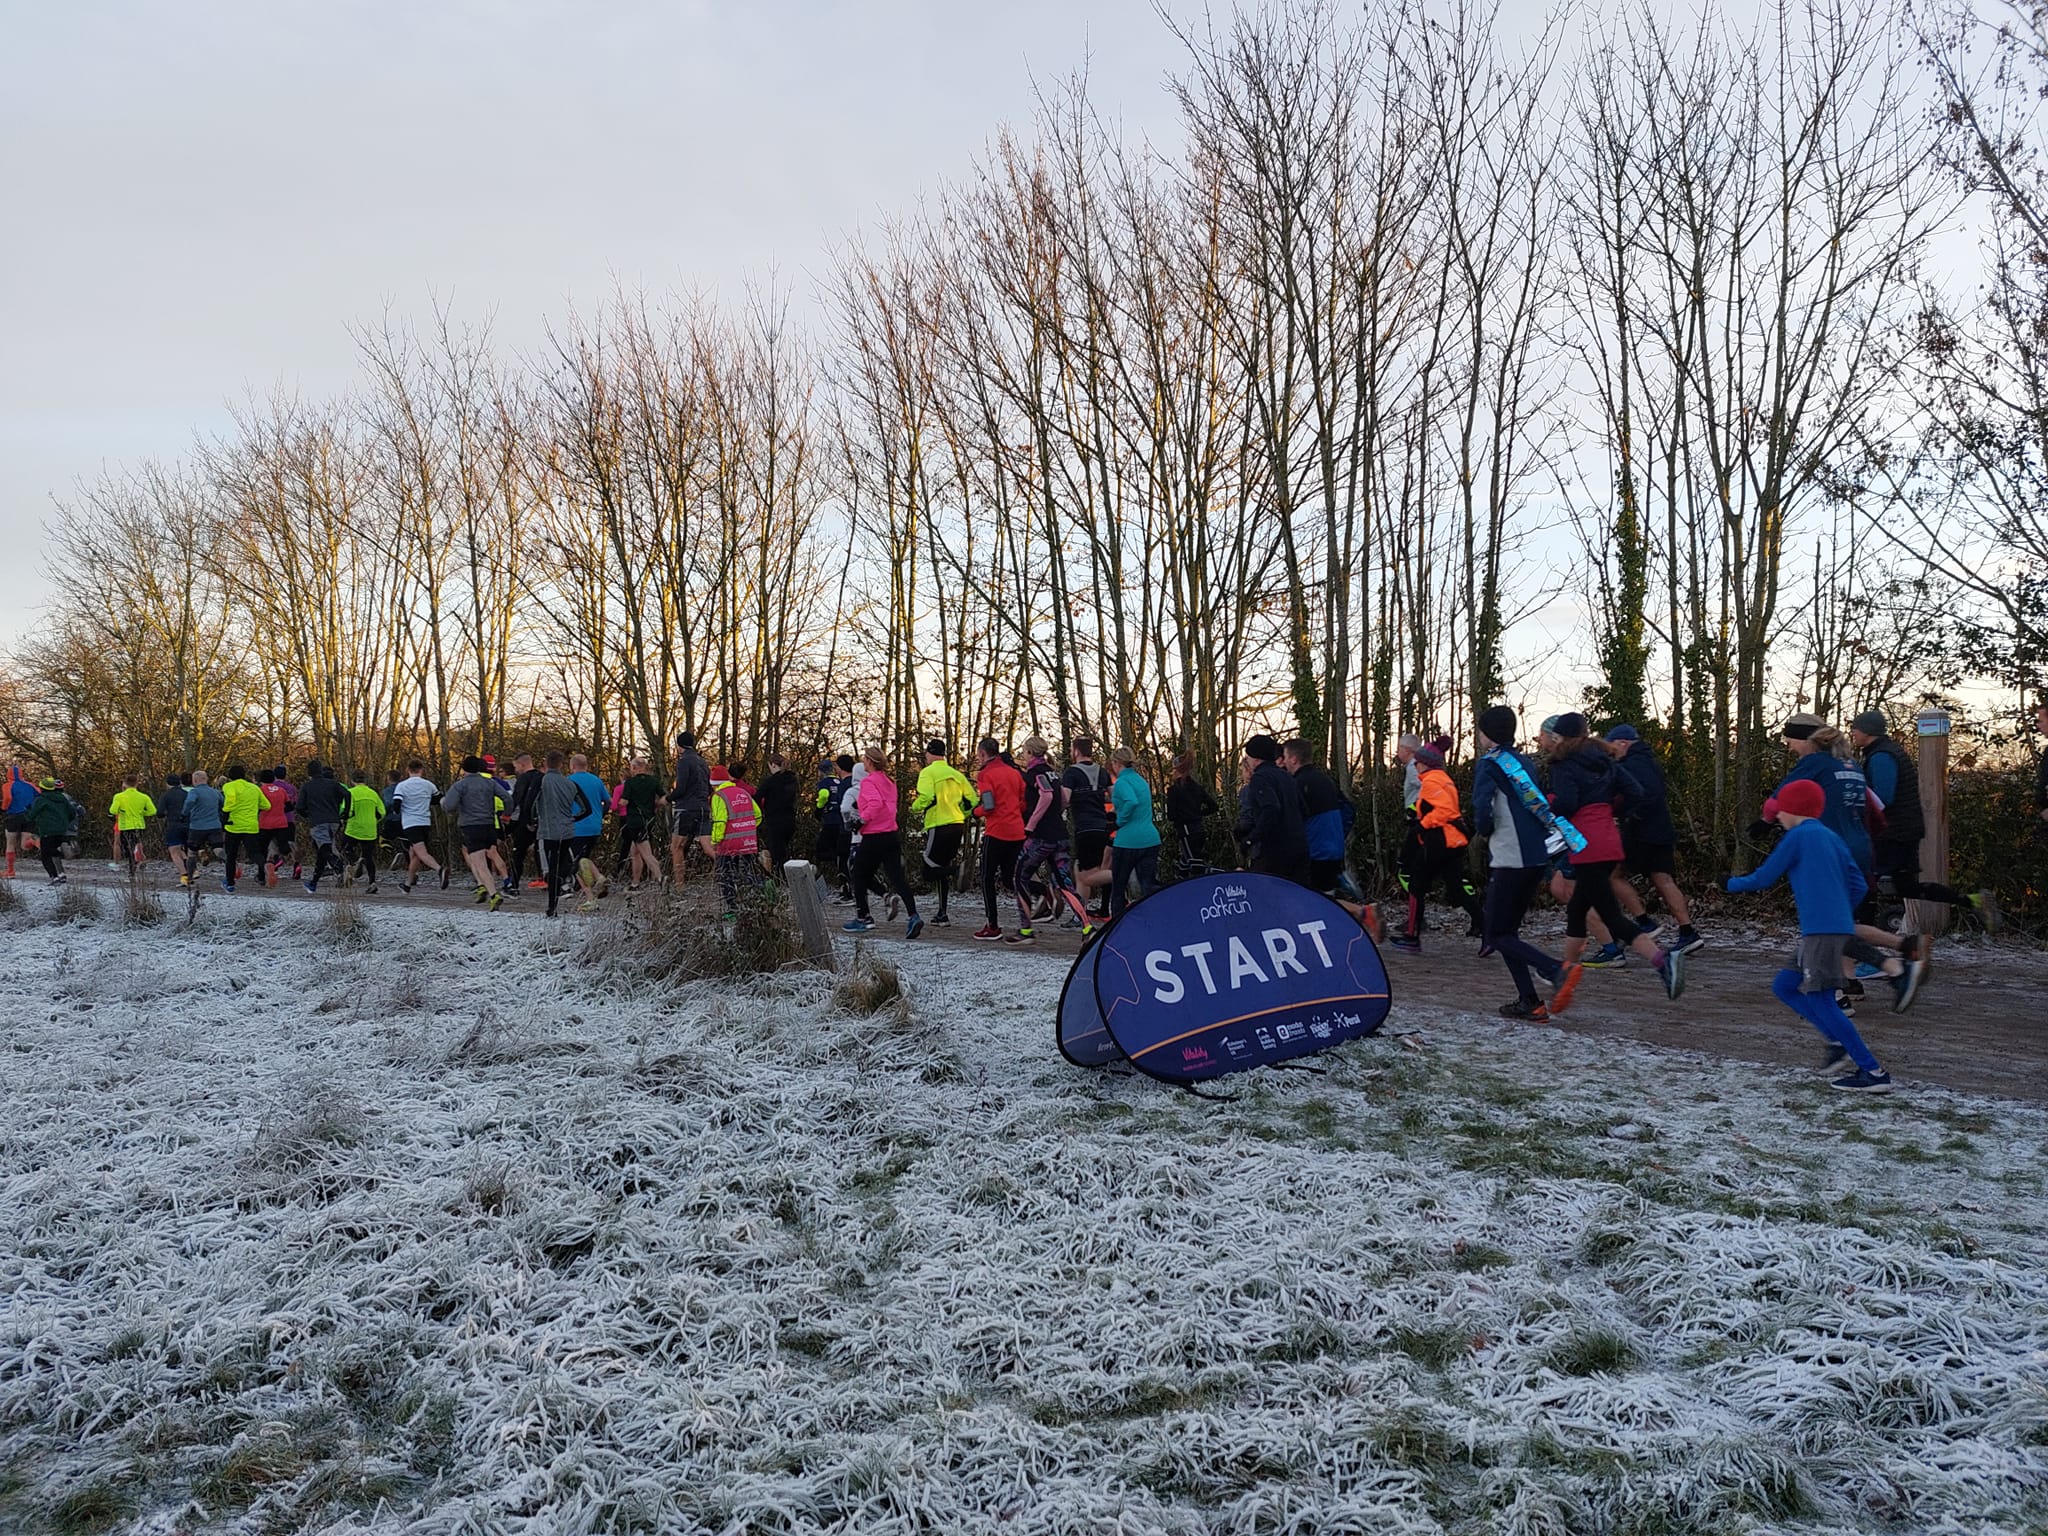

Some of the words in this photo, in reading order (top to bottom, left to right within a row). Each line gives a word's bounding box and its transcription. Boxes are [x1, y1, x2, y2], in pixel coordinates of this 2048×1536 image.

[1225, 884, 1247, 899] Vitality
[1200, 897, 1252, 924] parkrun
[1144, 919, 1334, 1004] START
